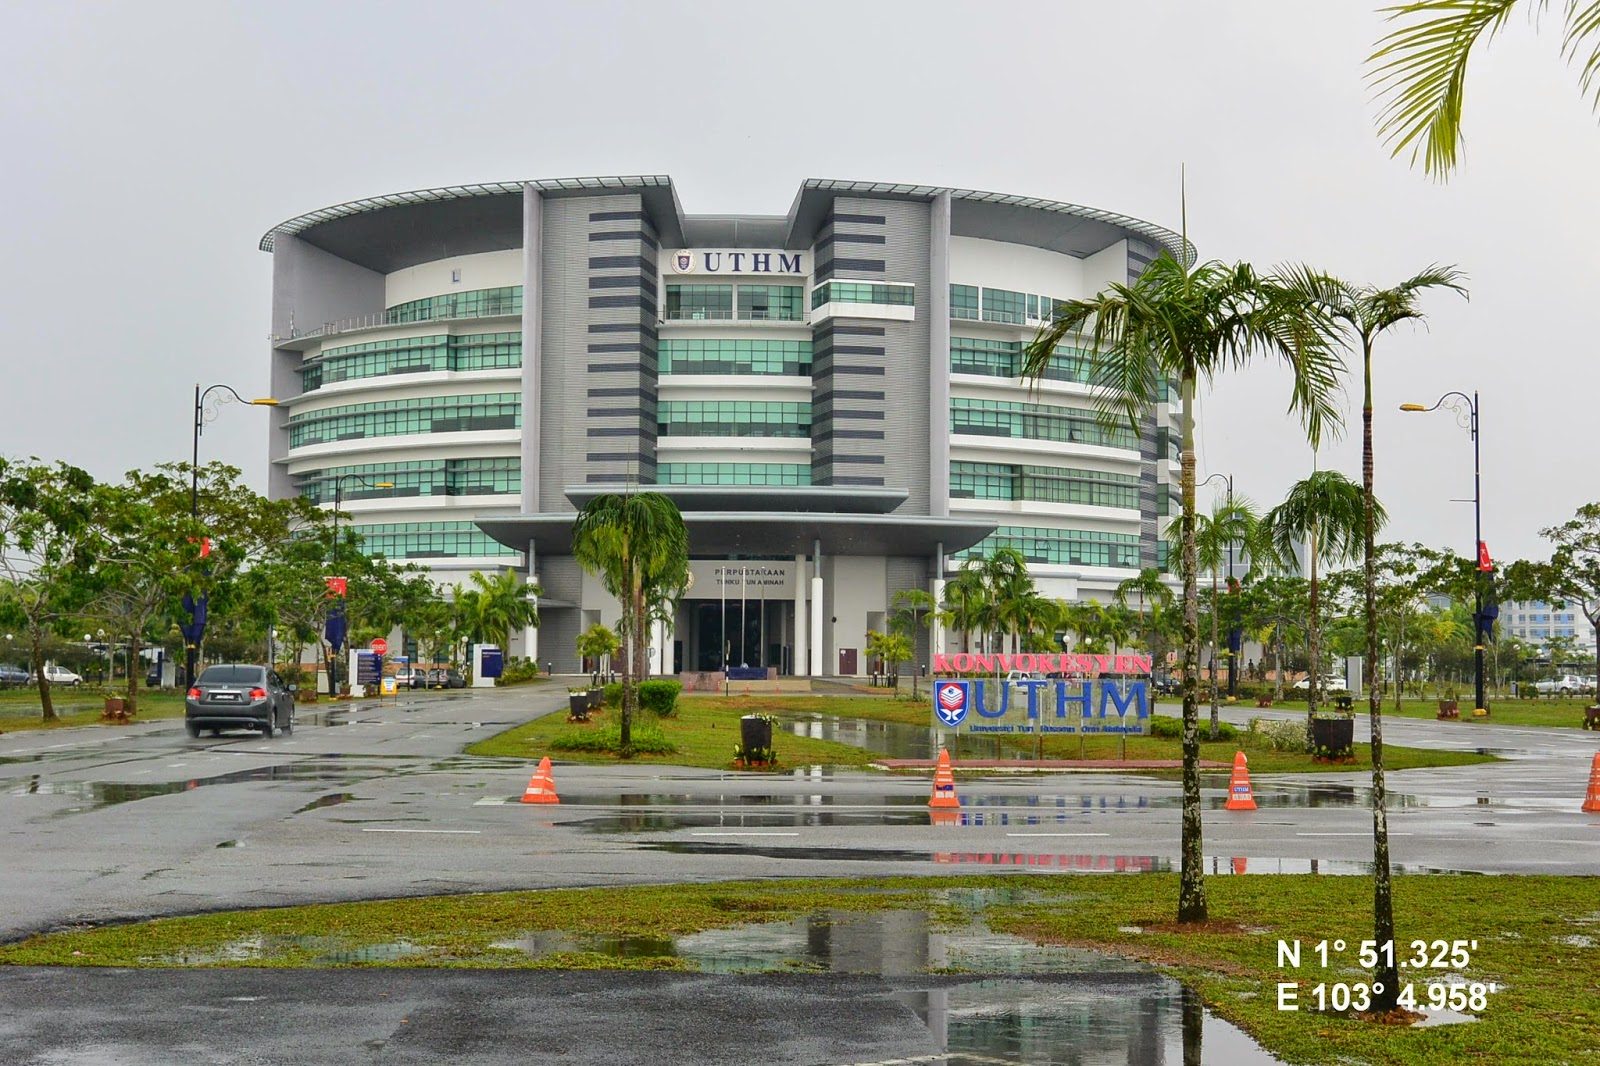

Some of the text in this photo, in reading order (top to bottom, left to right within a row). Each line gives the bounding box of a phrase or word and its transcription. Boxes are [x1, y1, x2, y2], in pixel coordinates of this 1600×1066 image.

[703, 252, 802, 273] UTHM
[933, 653, 1151, 673] KONVOKESYEN
[974, 680, 1149, 719] UTHM
